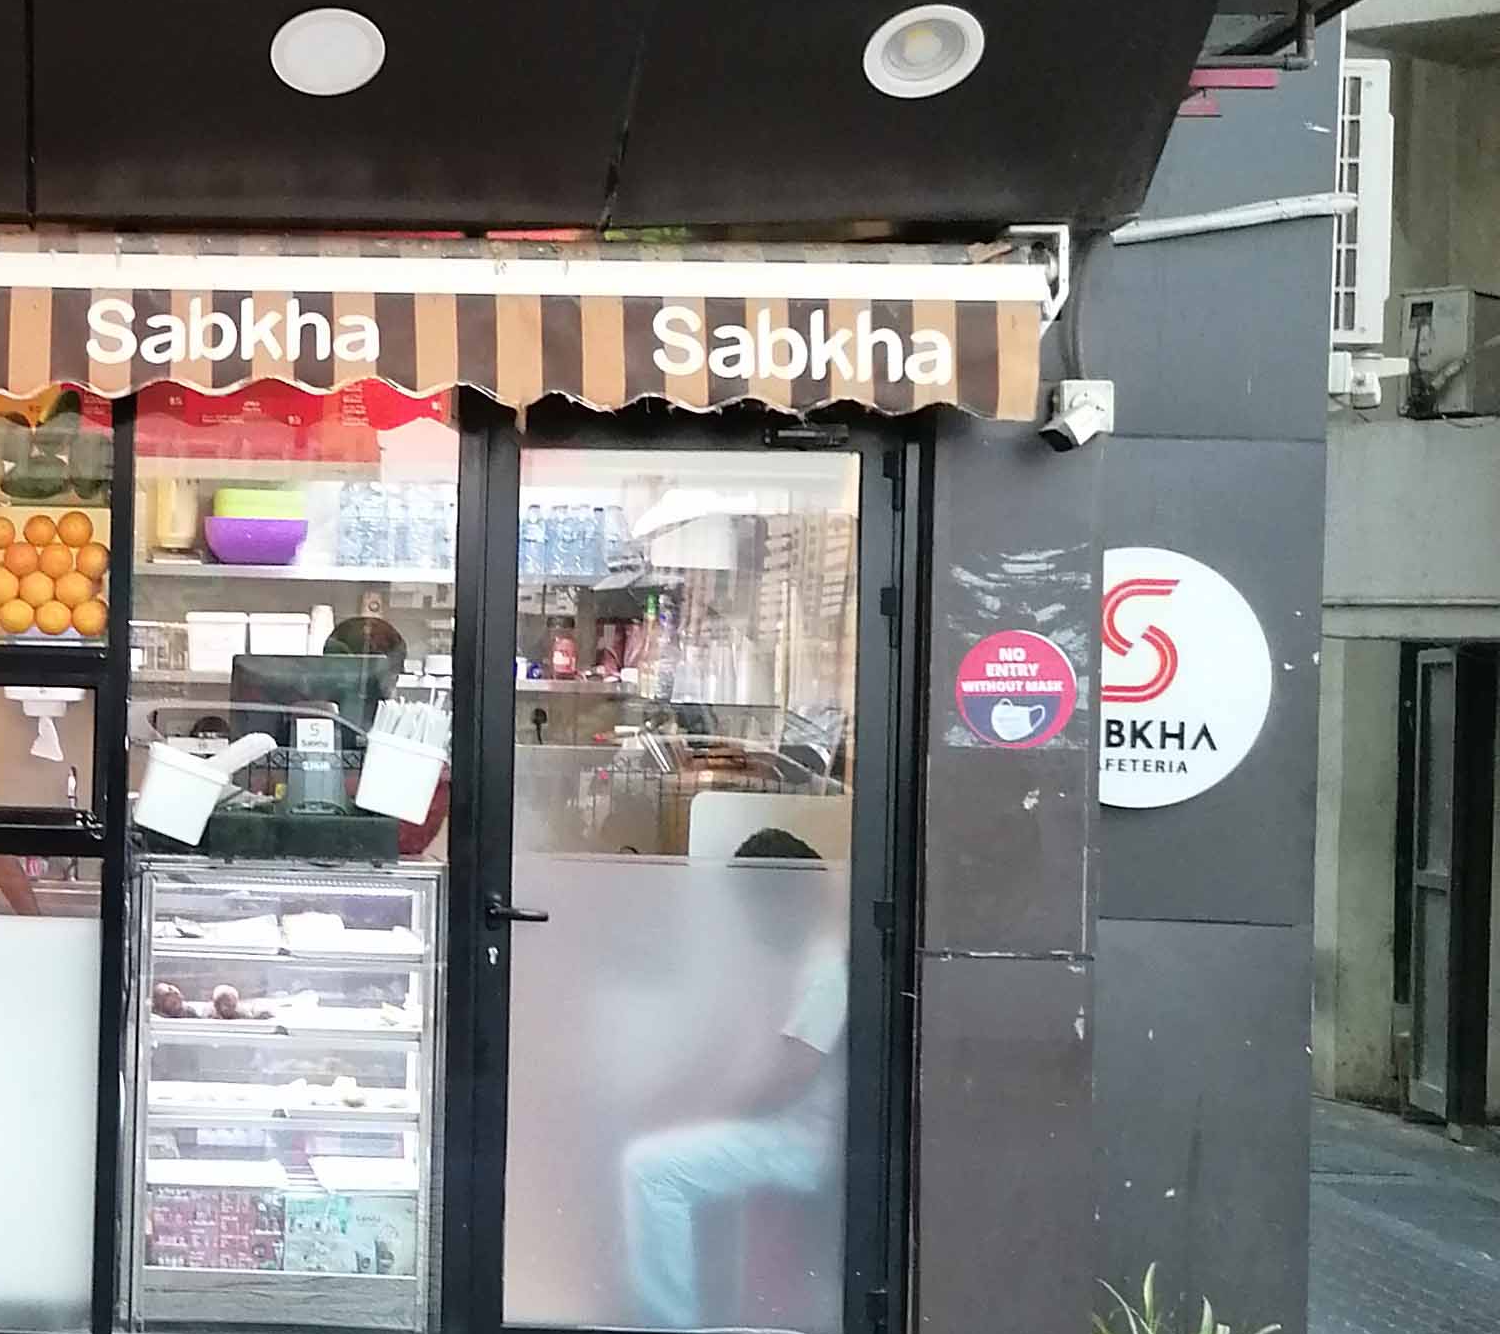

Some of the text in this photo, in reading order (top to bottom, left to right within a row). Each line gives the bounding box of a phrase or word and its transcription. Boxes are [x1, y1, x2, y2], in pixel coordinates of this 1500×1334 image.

[85, 298, 380, 365] Sabkha
[652, 305, 953, 386] Sabkha
[998, 647, 1026, 662] NO
[985, 663, 1040, 677] ENTRY
[961, 680, 1064, 692] WITHOUT MASK
[1105, 718, 1218, 751] BKHA
[1105, 758, 1188, 774] FETERIA
